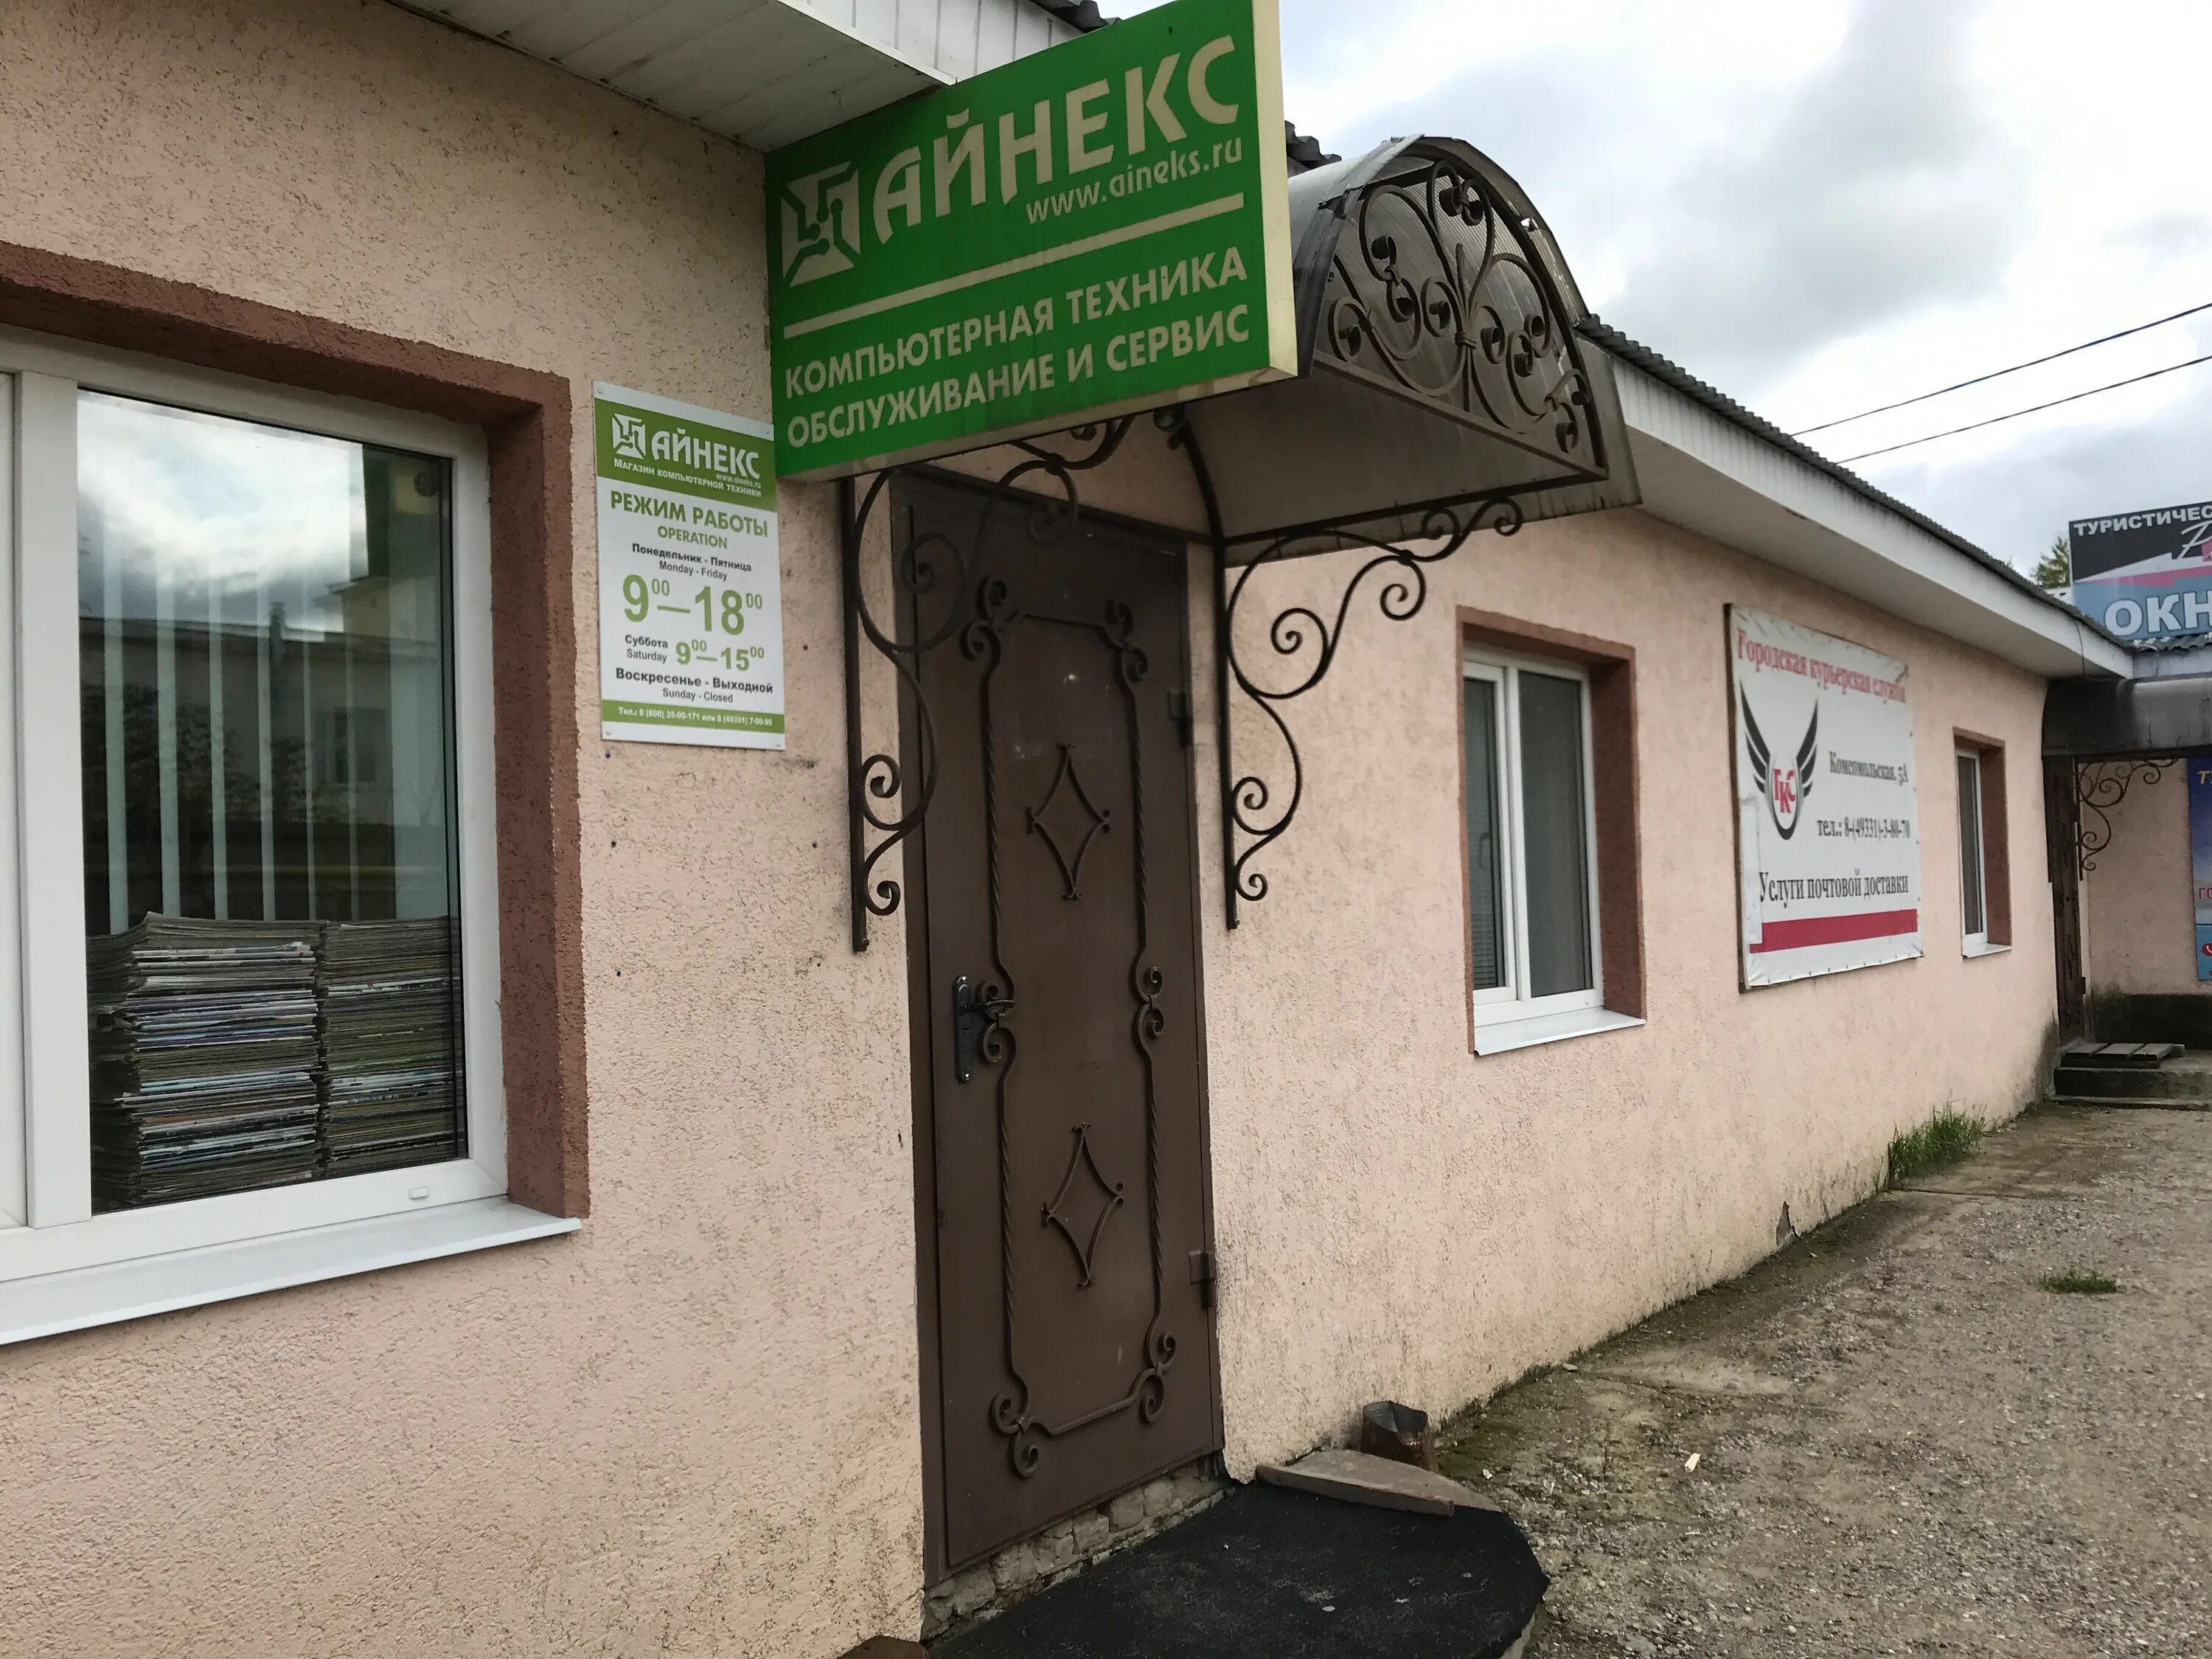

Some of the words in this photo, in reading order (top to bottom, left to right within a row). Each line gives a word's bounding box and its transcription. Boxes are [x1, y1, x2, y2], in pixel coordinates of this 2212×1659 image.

[873, 35, 1239, 244] АЙНЕКС
[1026, 137, 1242, 224] www.aineks.ru
[785, 297, 1055, 398] КОМПЬЮТЕРНАЯ
[1066, 246, 1248, 325] ТЕХНИКА
[787, 354, 1055, 448] ОБСЛУЖИВАНИЕ
[1068, 344, 1093, 380] И
[1106, 305, 1249, 372] СЕРВИС
[652, 427, 760, 479] АЙНЕКС
[611, 490, 686, 522] РЕЖИМ
[692, 507, 768, 537] РАБОТЫ
[2074, 505, 2212, 536] ТУРИСТИЧЕС
[658, 526, 727, 549] OPERATION
[632, 543, 702, 564] Понедельник
[711, 557, 751, 572] Пятница
[659, 561, 693, 576] Monday
[701, 568, 727, 581] Friday
[625, 634, 668, 648] Суббота
[627, 649, 667, 664] Saturday
[1736, 627, 1807, 677] Городская
[1809, 659, 1871, 695] курьерская
[616, 667, 701, 686] Воскресенье
[712, 677, 773, 694] Выходной
[663, 688, 696, 702] Sunday
[703, 692, 733, 703] Closed
[1817, 820, 1842, 837] тел.:
[1759, 872, 1804, 908] Услуги
[1807, 869, 1862, 900] почтовой
[1864, 875, 1909, 901] доставки
